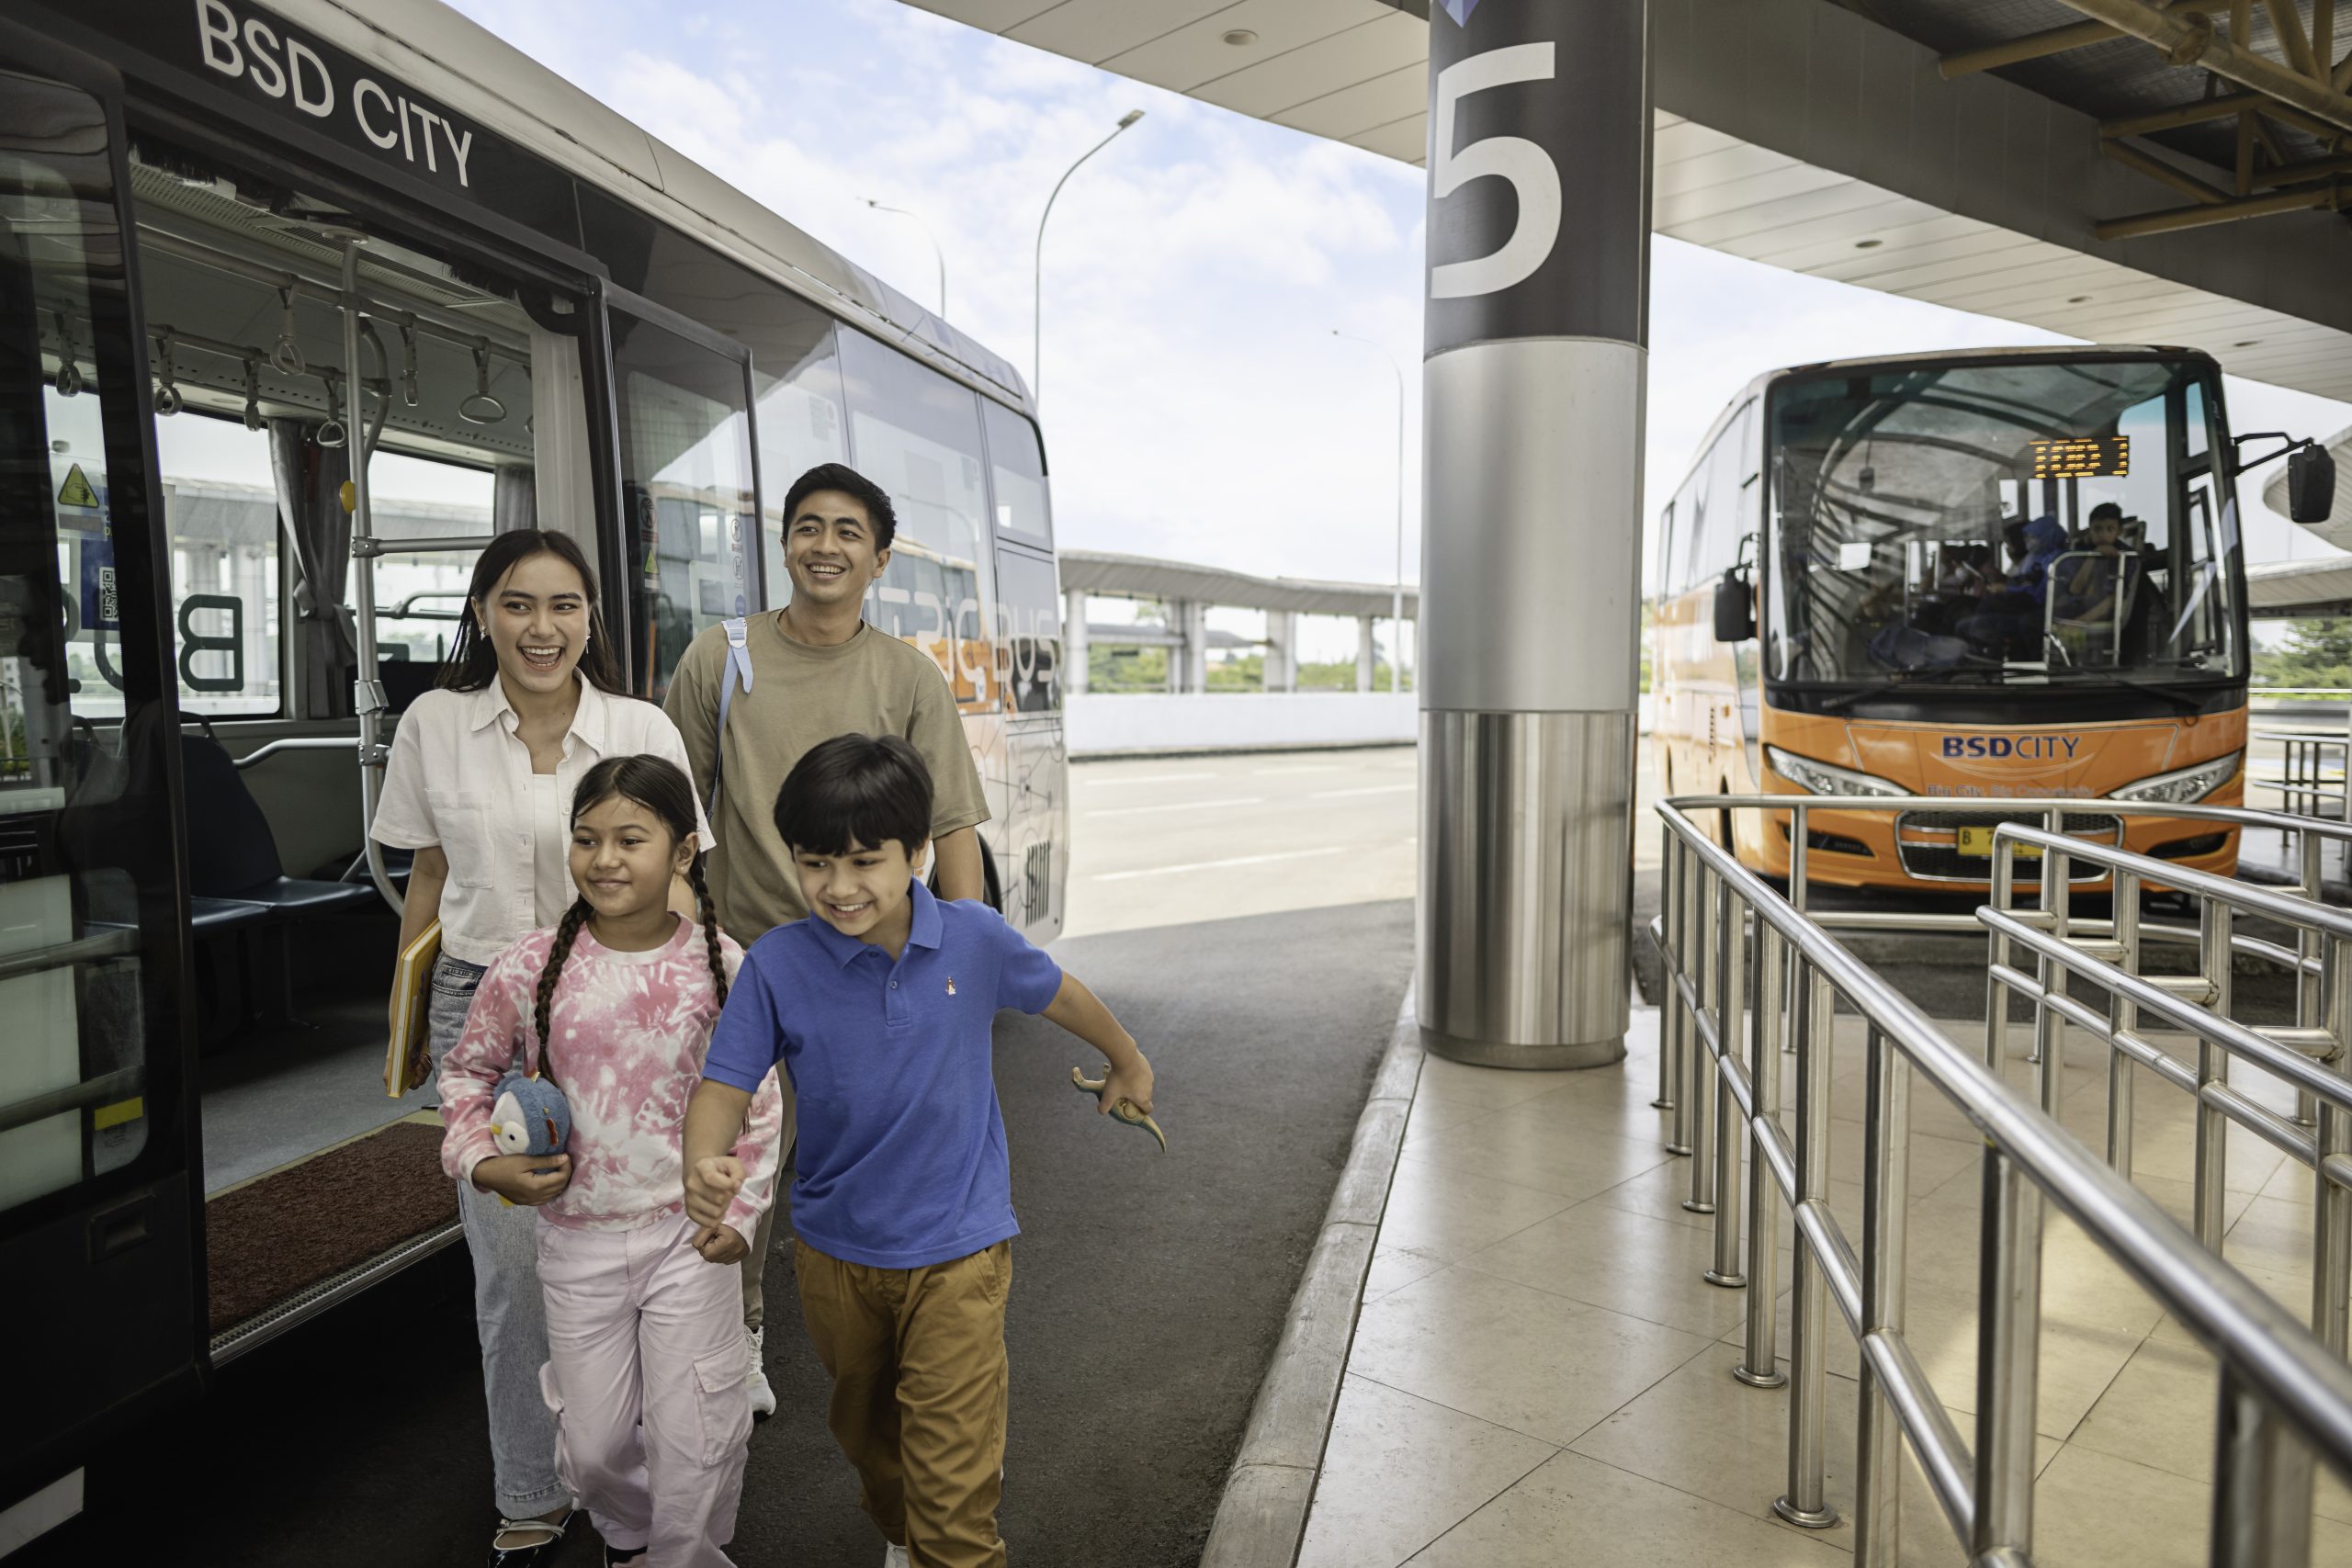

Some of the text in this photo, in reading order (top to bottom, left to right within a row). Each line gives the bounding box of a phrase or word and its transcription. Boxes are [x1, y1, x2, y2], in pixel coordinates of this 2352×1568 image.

[196, 0, 472, 187] BSD CITY
[1430, 41, 1562, 299] 5
[989, 602, 1055, 682] BUS
